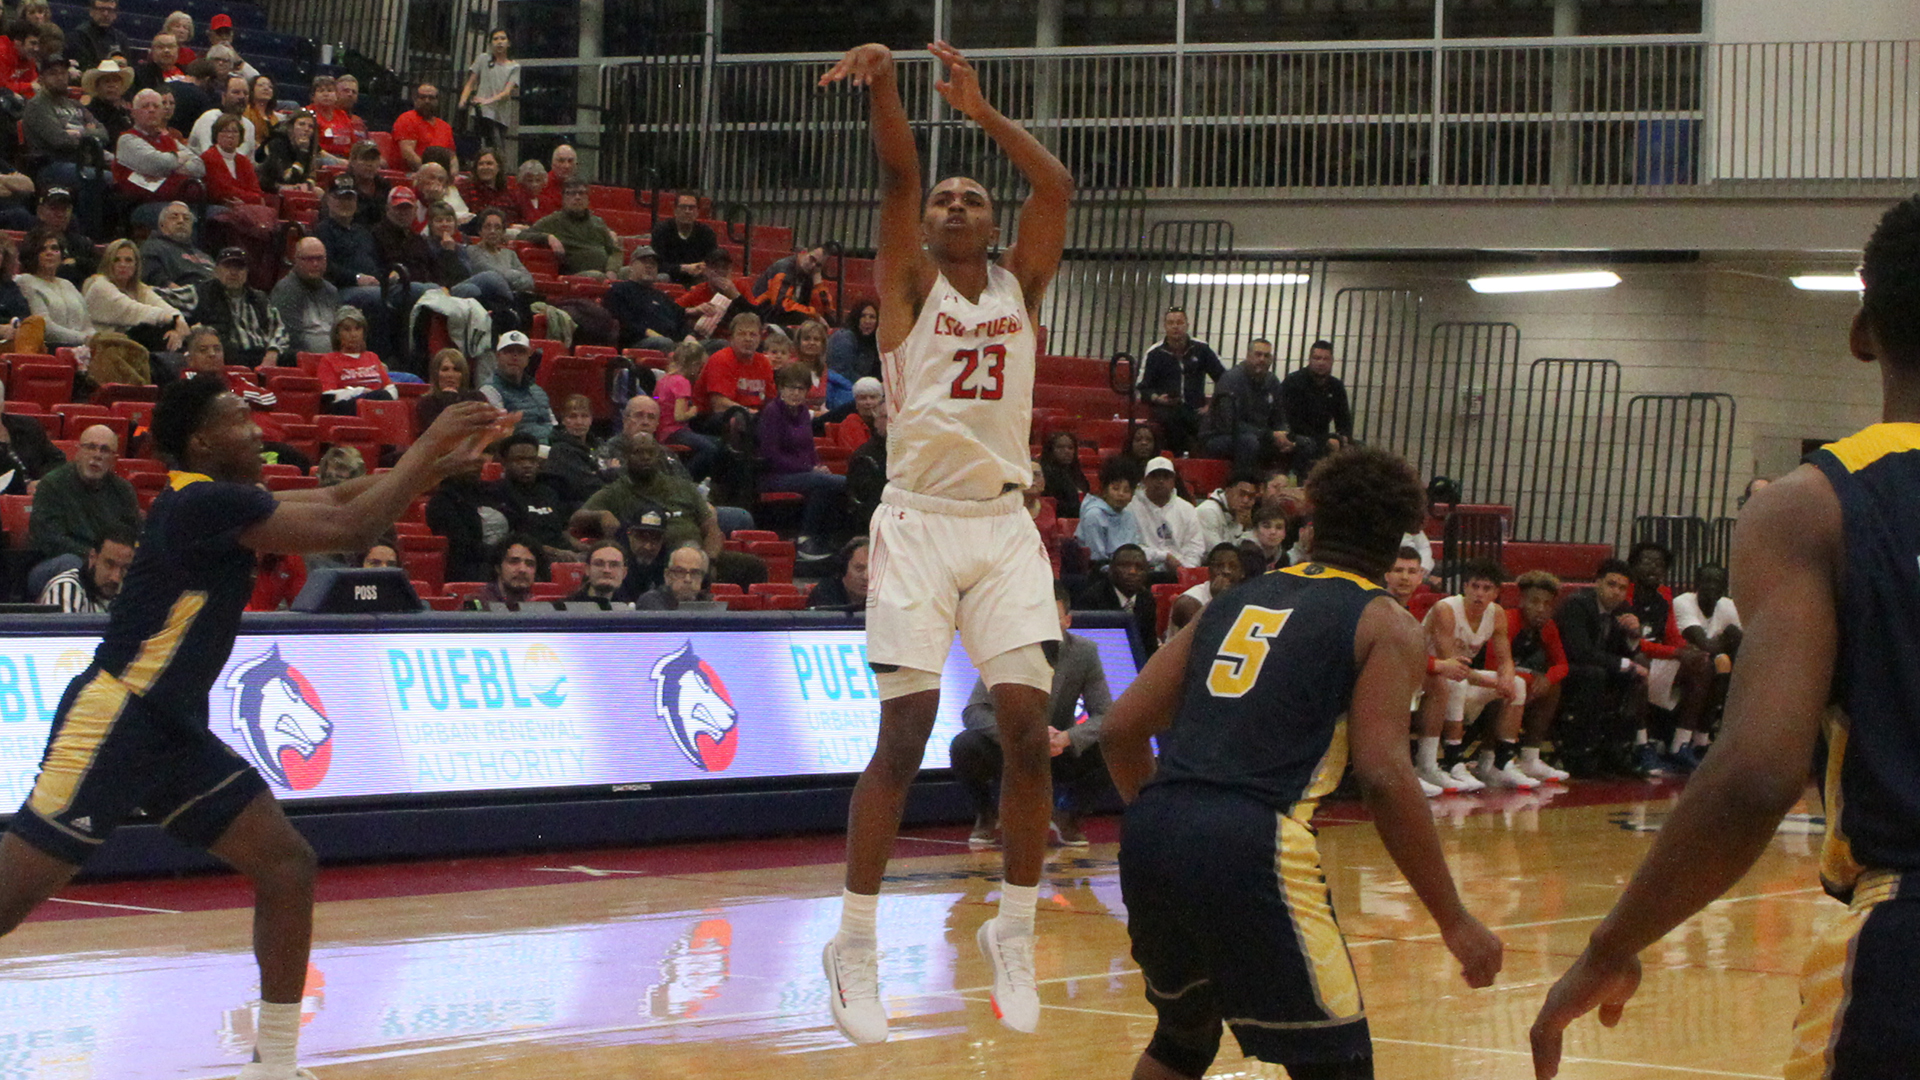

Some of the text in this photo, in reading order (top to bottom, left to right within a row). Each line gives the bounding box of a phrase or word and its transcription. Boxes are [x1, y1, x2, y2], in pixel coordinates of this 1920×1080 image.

[935, 311, 965, 337] CSU
[950, 344, 1006, 400] 23
[354, 585, 378, 600] POSS
[1206, 604, 1294, 698] 5
[405, 718, 583, 744] URBAN RENEWAL
[417, 746, 586, 783] AUTHORITY
